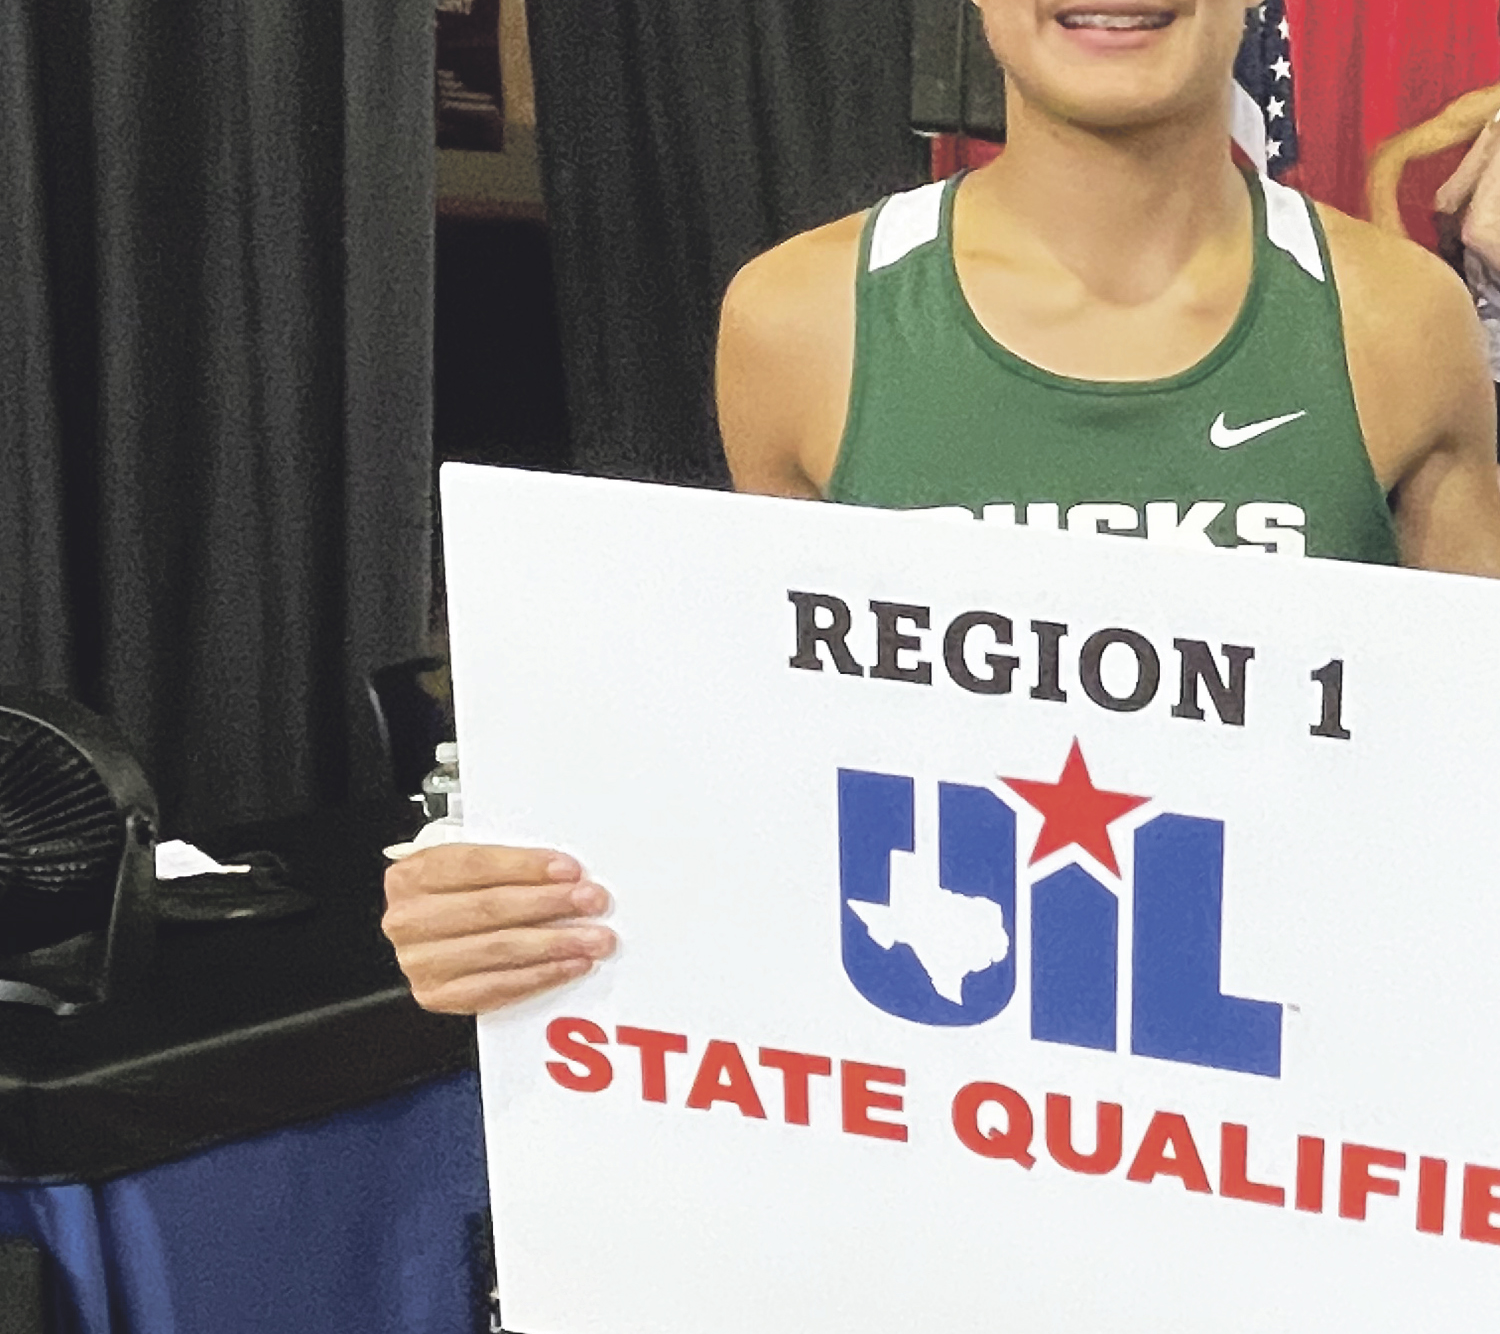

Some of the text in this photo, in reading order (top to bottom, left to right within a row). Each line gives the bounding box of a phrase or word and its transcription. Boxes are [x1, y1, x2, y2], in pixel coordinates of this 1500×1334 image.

[788, 590, 1351, 740] REGION 1
[546, 1016, 909, 1143] STATE
